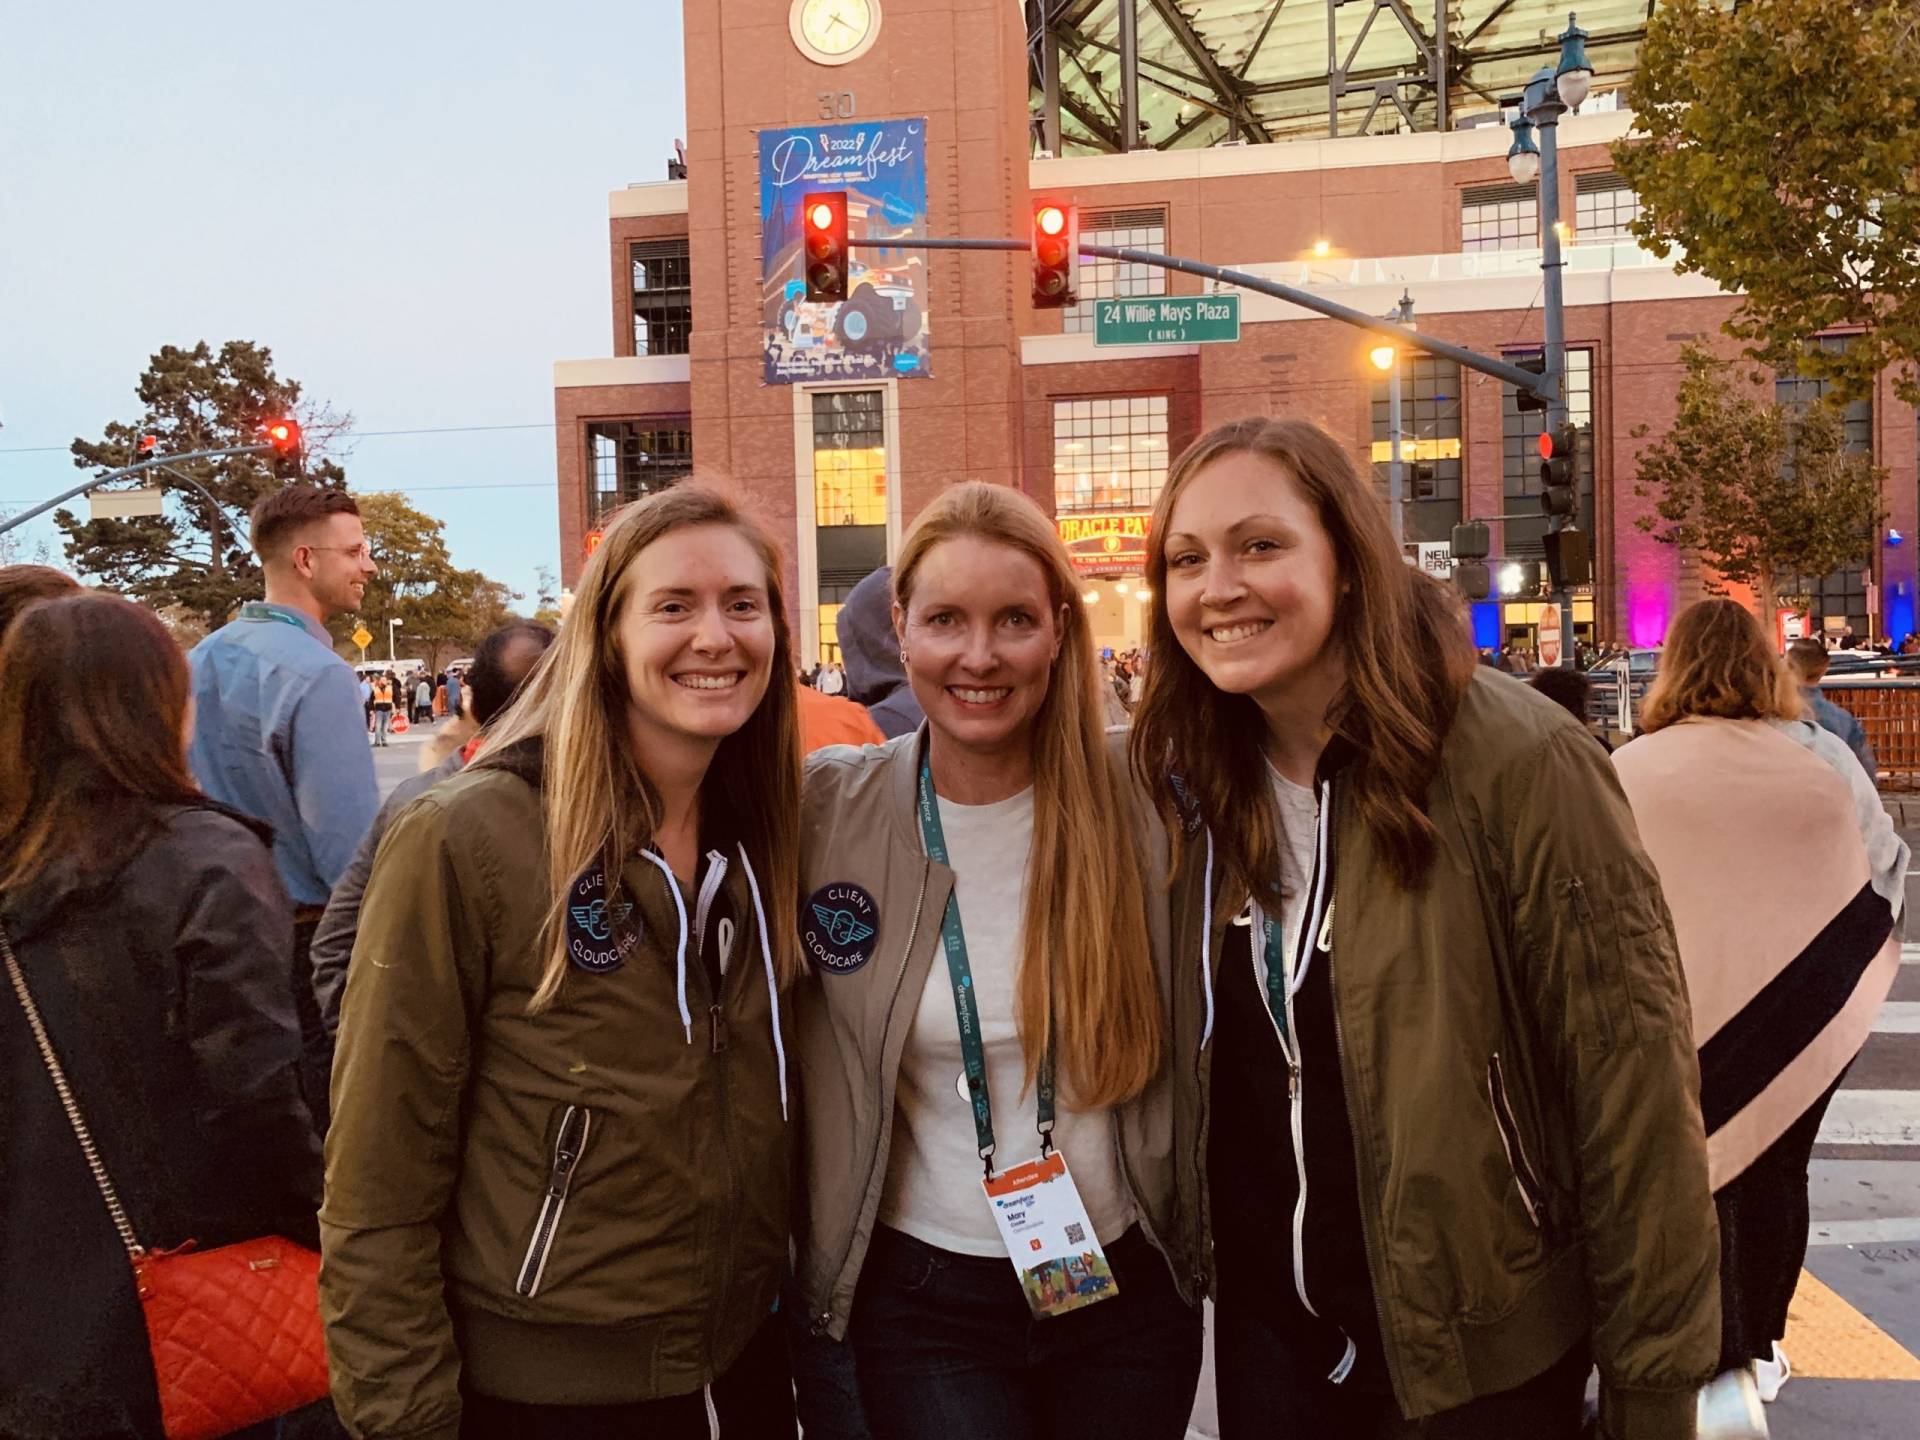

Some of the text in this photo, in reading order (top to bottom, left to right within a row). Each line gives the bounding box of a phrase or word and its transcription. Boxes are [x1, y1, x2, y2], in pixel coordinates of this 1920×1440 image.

[817, 91, 856, 120] 30
[772, 131, 913, 187] Dreamfest
[831, 139, 856, 151] 2022
[1104, 302, 1230, 325] 24 Willie Mays Plaza
[1060, 518, 1119, 541] ORACLE
[920, 776, 932, 822] dreamforce
[579, 874, 604, 895] CLIE
[828, 887, 872, 914] CLIENT
[573, 931, 637, 964] CLOUDCARE
[805, 930, 864, 967] CLOUDCARE
[957, 985, 971, 1035] dreamforce
[1007, 1211, 1026, 1221] Mary
